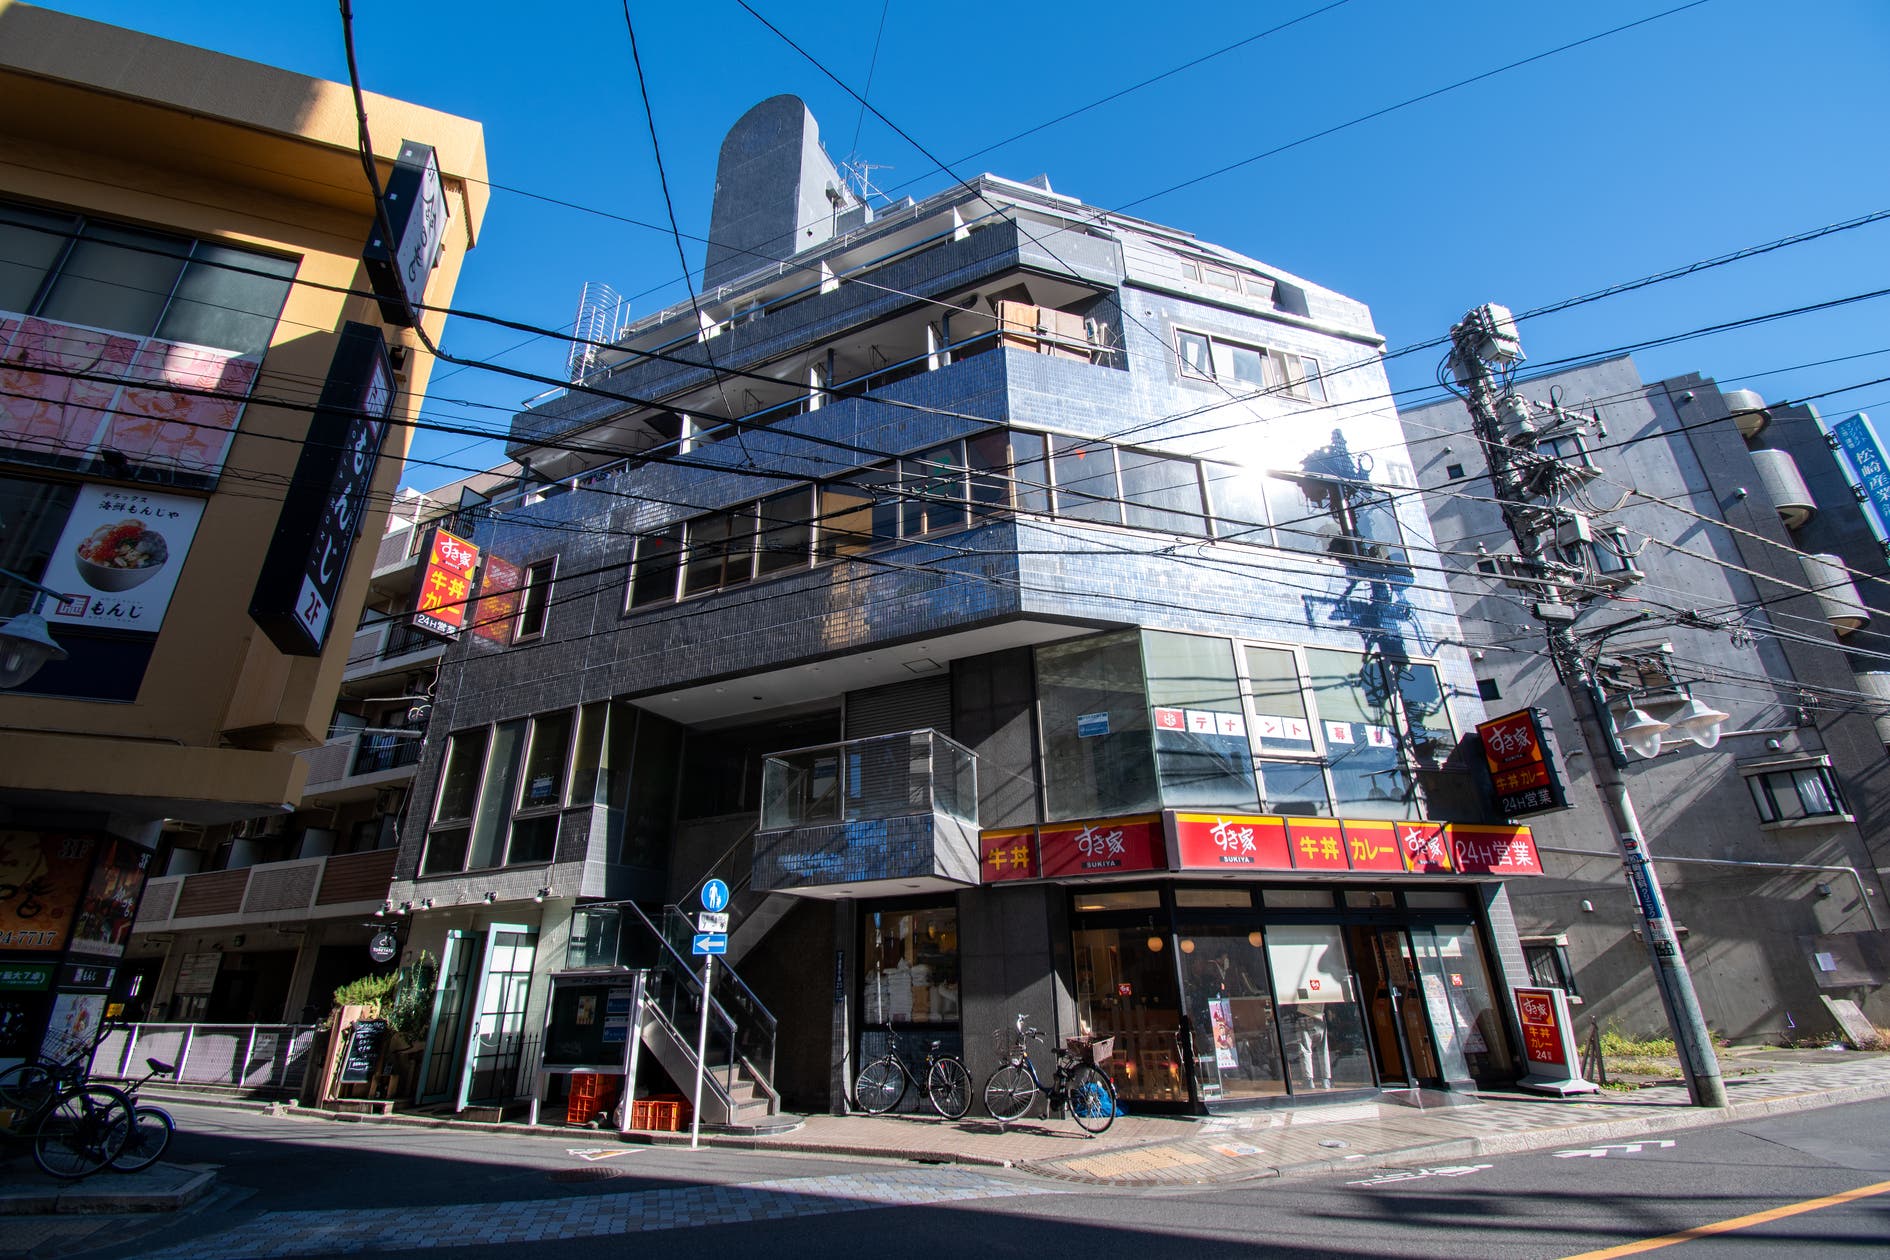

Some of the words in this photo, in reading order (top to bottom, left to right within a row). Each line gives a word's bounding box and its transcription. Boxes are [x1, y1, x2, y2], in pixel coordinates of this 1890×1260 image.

[98, 500, 180, 519] 海鮮もんじゃ
[318, 427, 367, 585] もんじ
[440, 537, 472, 568] すき家
[430, 570, 465, 599] 牛丼
[91, 600, 144, 619] もんじ
[304, 589, 322, 622] 2F
[423, 592, 460, 615] カレー
[1488, 725, 1531, 754] すき家
[1502, 789, 1552, 813] 24H営業
[1074, 824, 1126, 859] すき家
[1209, 816, 1257, 856] すき家
[1300, 836, 1340, 861] 牛丼
[1405, 826, 1444, 860] すき家
[988, 845, 1030, 871] 牛丼
[1351, 837, 1394, 861] カレー
[1455, 840, 1534, 867] 24H営業
[1086, 860, 1116, 868] SUKIYA
[1523, 997, 1548, 1017] すき家
[1529, 1026, 1551, 1038] 牛丼
[1530, 1038, 1553, 1048] カレー
